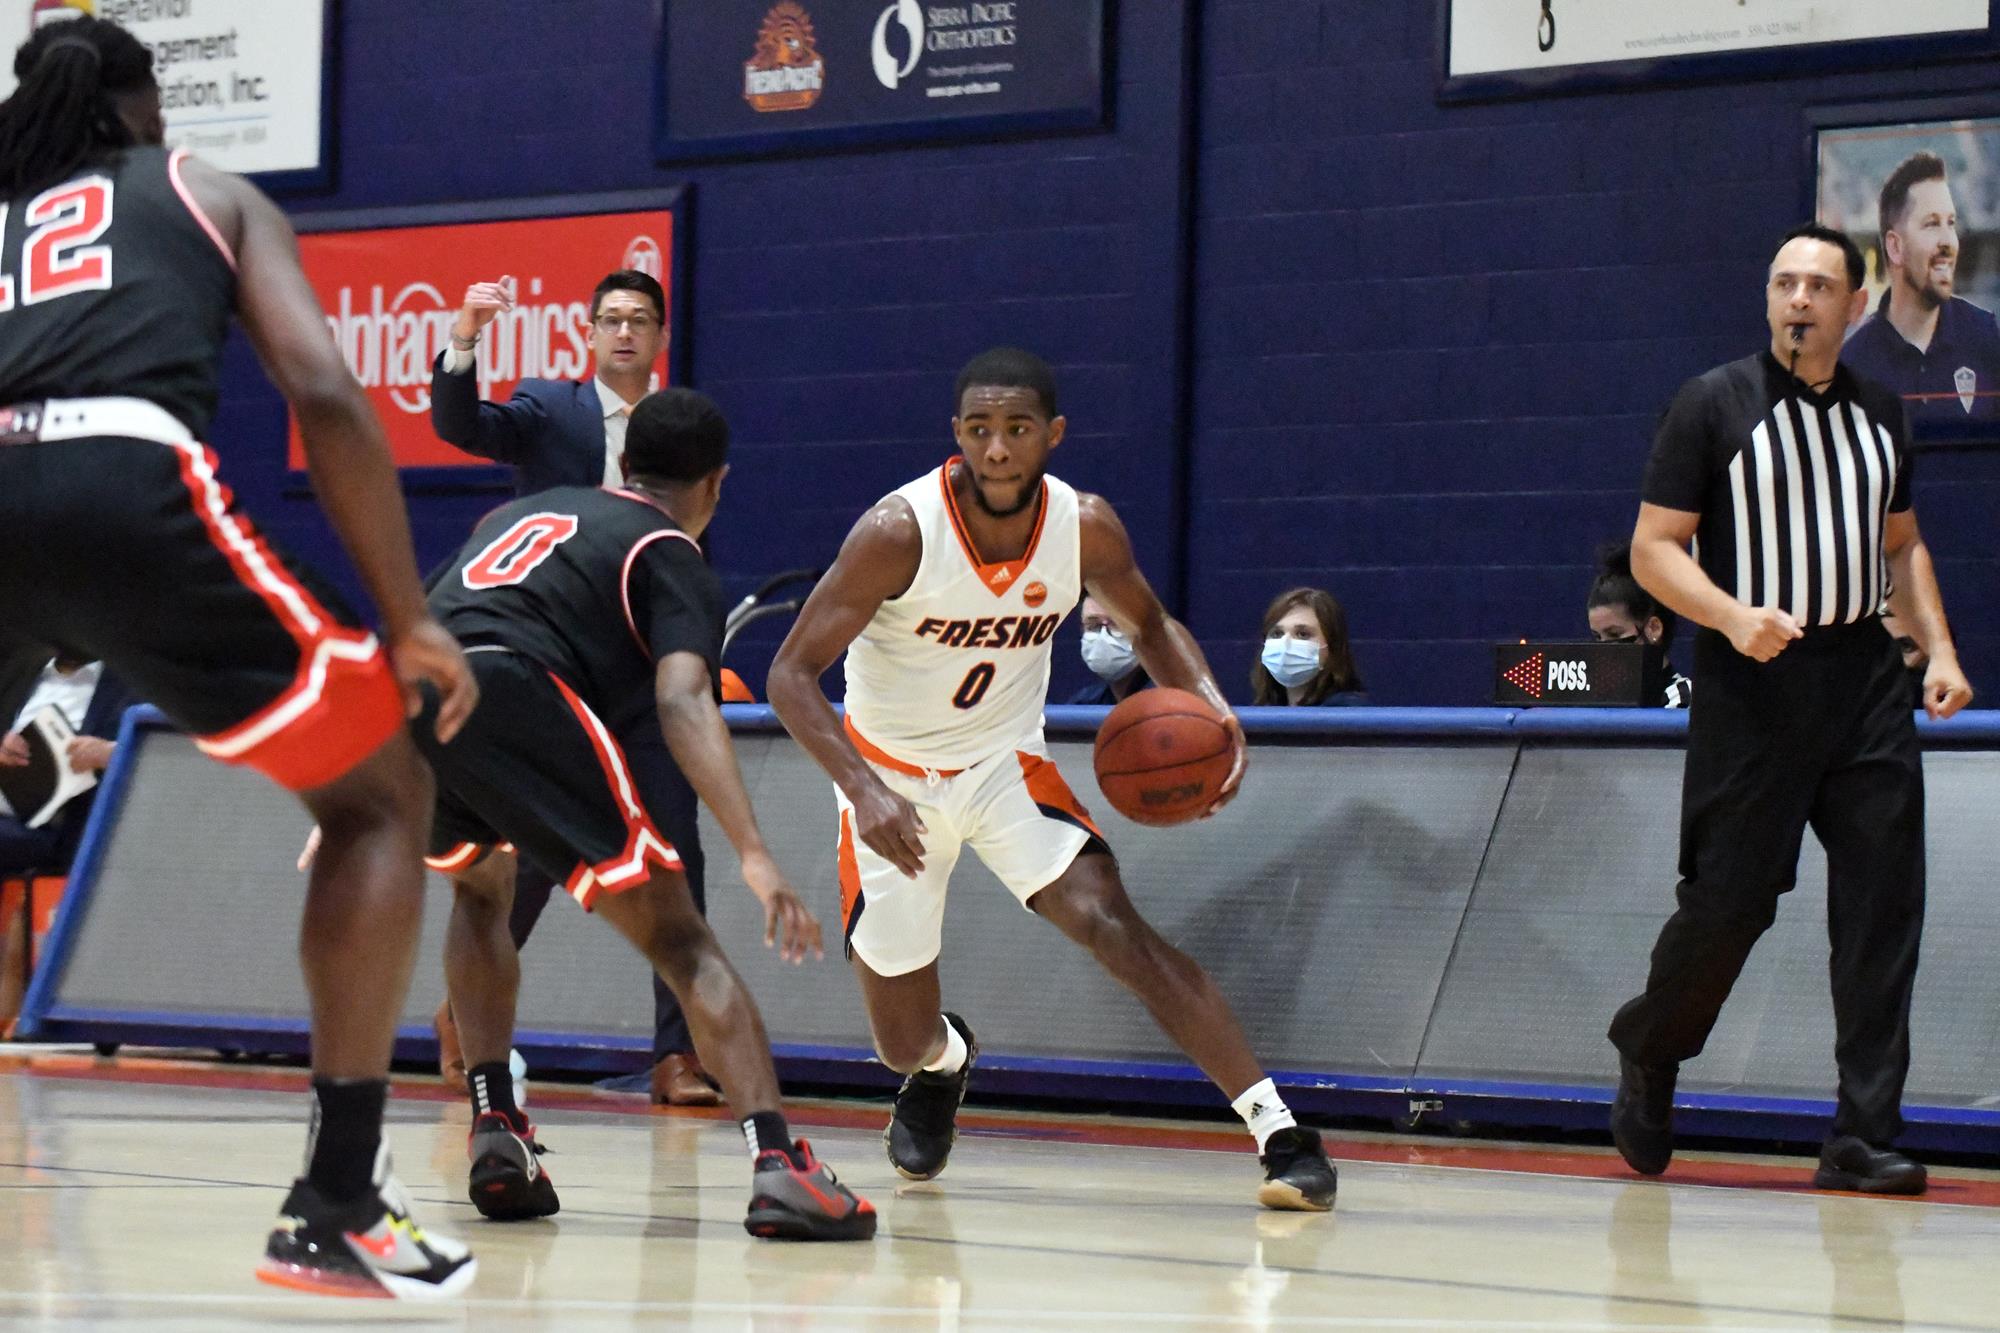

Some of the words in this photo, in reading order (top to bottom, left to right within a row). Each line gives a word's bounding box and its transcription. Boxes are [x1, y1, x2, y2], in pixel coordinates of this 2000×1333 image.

[145, 28, 237, 72] gement
[462, 512, 578, 590] 0
[914, 613, 1060, 648] FRESNO
[951, 661, 996, 710] 0
[1548, 660, 1590, 691] POSS.
